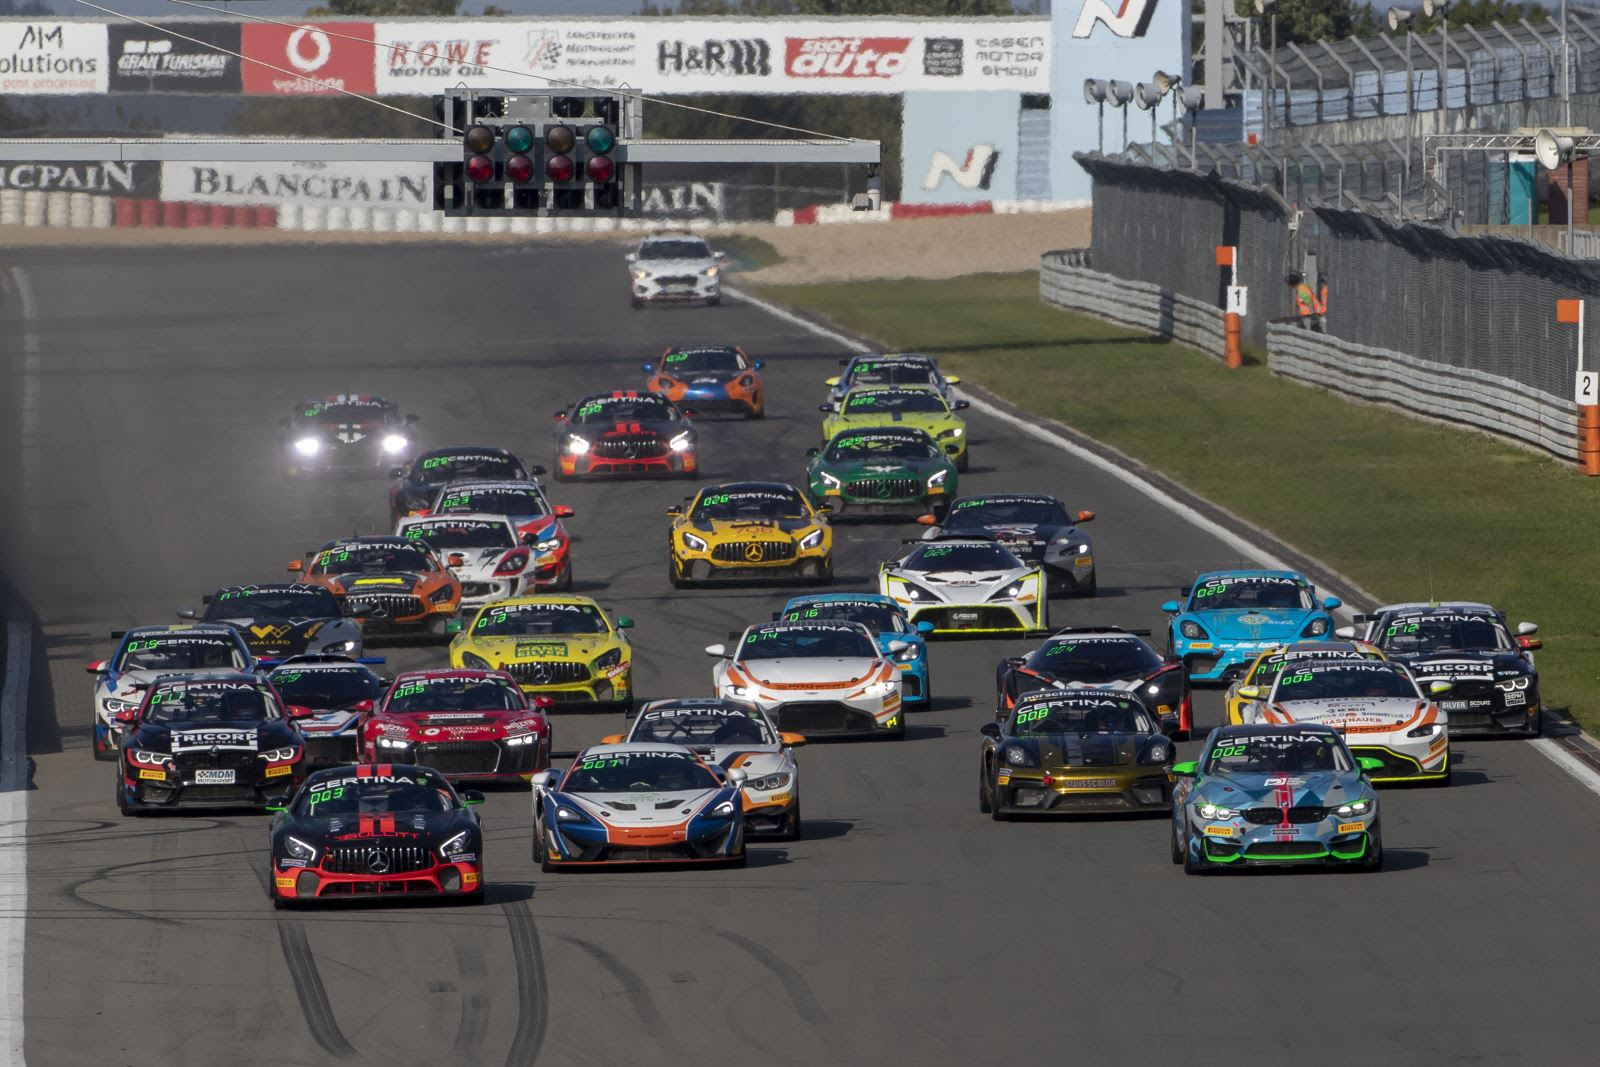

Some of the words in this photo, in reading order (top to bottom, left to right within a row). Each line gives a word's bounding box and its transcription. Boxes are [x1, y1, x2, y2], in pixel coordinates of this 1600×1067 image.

[389, 40, 498, 66] ROWE
[800, 38, 862, 56] sport
[656, 39, 726, 74] H&R
[791, 49, 909, 75] auto
[192, 166, 428, 203] BLANCPAIN
[1582, 375, 1591, 396] 2
[863, 434, 915, 443] CERTINA
[448, 455, 502, 463] CERTINA
[446, 488, 527, 500] CERTINA
[728, 491, 787, 501] CERTINA
[408, 521, 491, 532] CERTINA
[331, 543, 416, 555] CERTINA
[1204, 576, 1296, 588] CERTINA
[250, 588, 314, 596] CERTINA
[1196, 584, 1227, 599] 020
[490, 604, 581, 616] CERTINA
[812, 600, 880, 609] CERTINA
[1390, 615, 1487, 626] CERTINA
[759, 624, 854, 634] CERTINA
[127, 639, 157, 653] 015
[156, 638, 225, 646] CERTINA
[1267, 649, 1365, 664] CERTINA
[1294, 665, 1393, 675] CERTINA
[156, 683, 255, 695] CERTINA
[400, 677, 496, 690] CERTINA
[393, 684, 426, 699] 005
[1023, 690, 1135, 703] porsche-ticino.ch
[1017, 698, 1118, 714] CERTINA
[1441, 701, 1467, 710] SILVER
[644, 708, 746, 720] CERTINA
[1016, 707, 1050, 725] 008
[171, 733, 257, 742] TRICORP
[1216, 735, 1323, 747] CERTINA
[581, 751, 685, 762] CERTINA
[1210, 745, 1246, 759] 002
[582, 759, 620, 771] 007
[208, 770, 234, 779] MDM
[309, 776, 415, 793] CERTINA
[310, 787, 345, 805] 003
[1207, 827, 1231, 836] PIRELLI
[1340, 823, 1364, 833] PIRELLI
